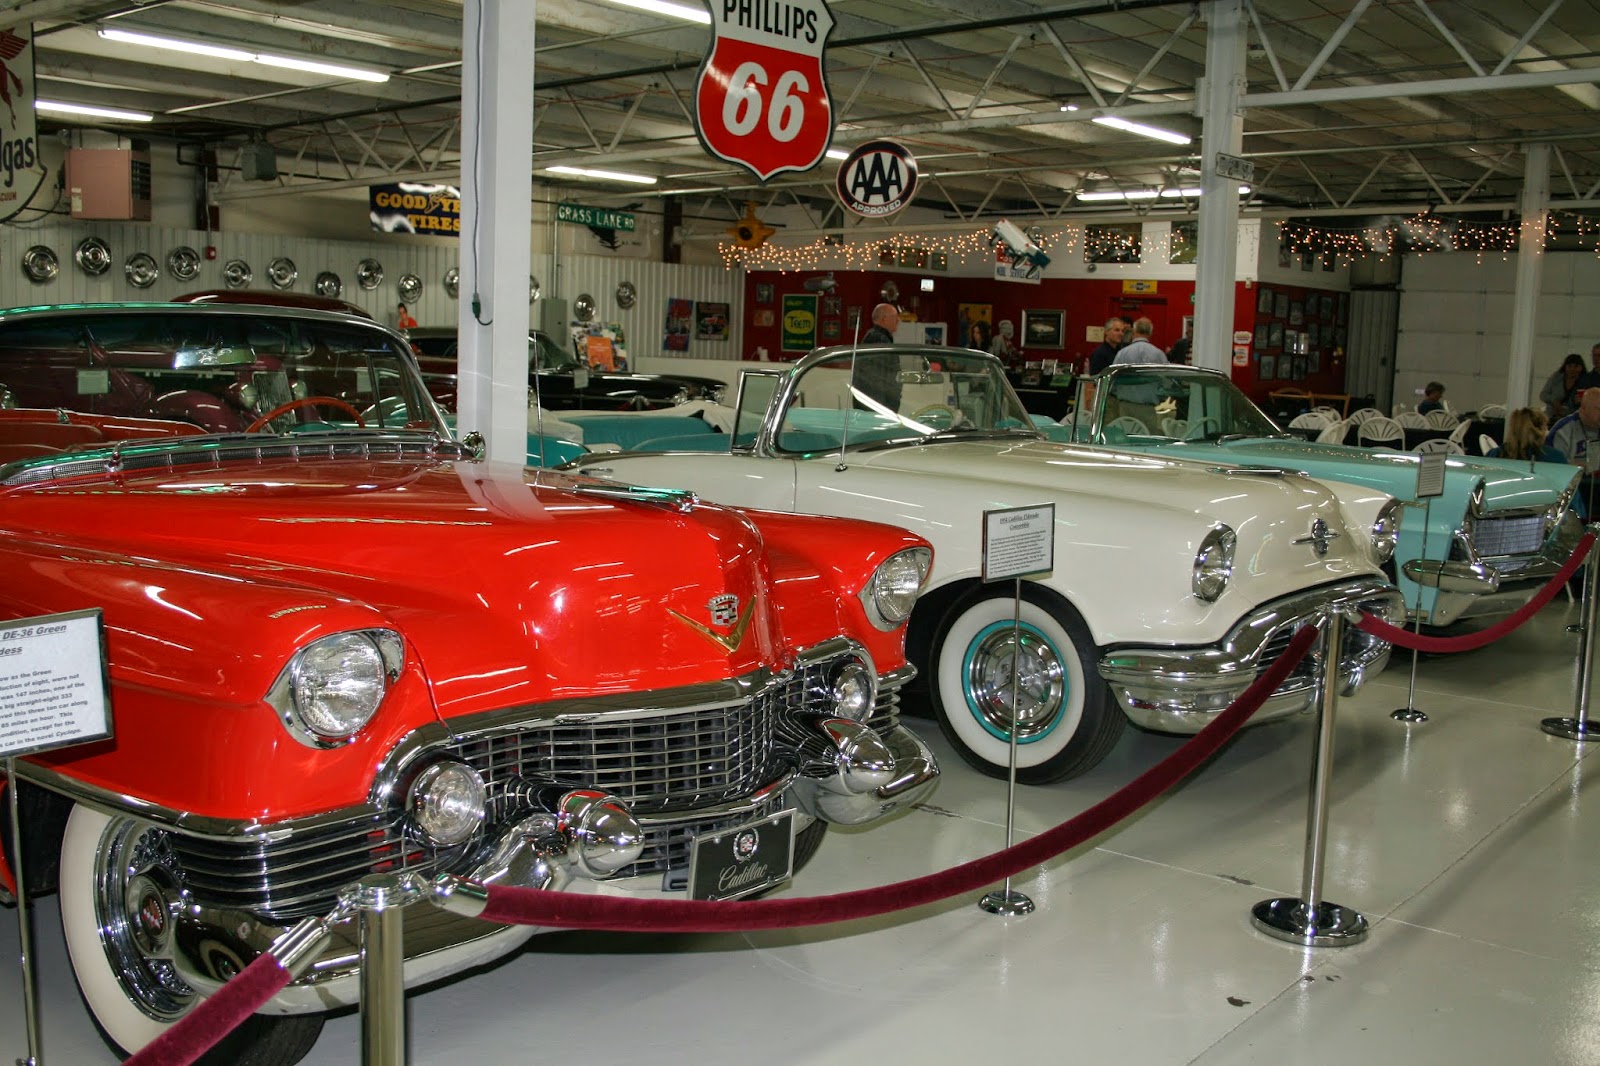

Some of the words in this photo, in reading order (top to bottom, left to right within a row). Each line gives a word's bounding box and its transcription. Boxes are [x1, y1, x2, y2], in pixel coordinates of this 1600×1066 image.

[723, 0, 818, 43] PHILLIPS
[722, 61, 810, 143] 66
[851, 153, 902, 204] AAA
[559, 206, 592, 223] GRASS
[596, 211, 622, 228] LAKE
[624, 218, 634, 228] RD
[851, 200, 901, 214] APPROVED
[407, 214, 460, 232] TIRES
[3, 628, 34, 639] DE-36
[36, 625, 67, 635] Green
[31, 724, 53, 732] except
[718, 861, 768, 891] Cadillac
